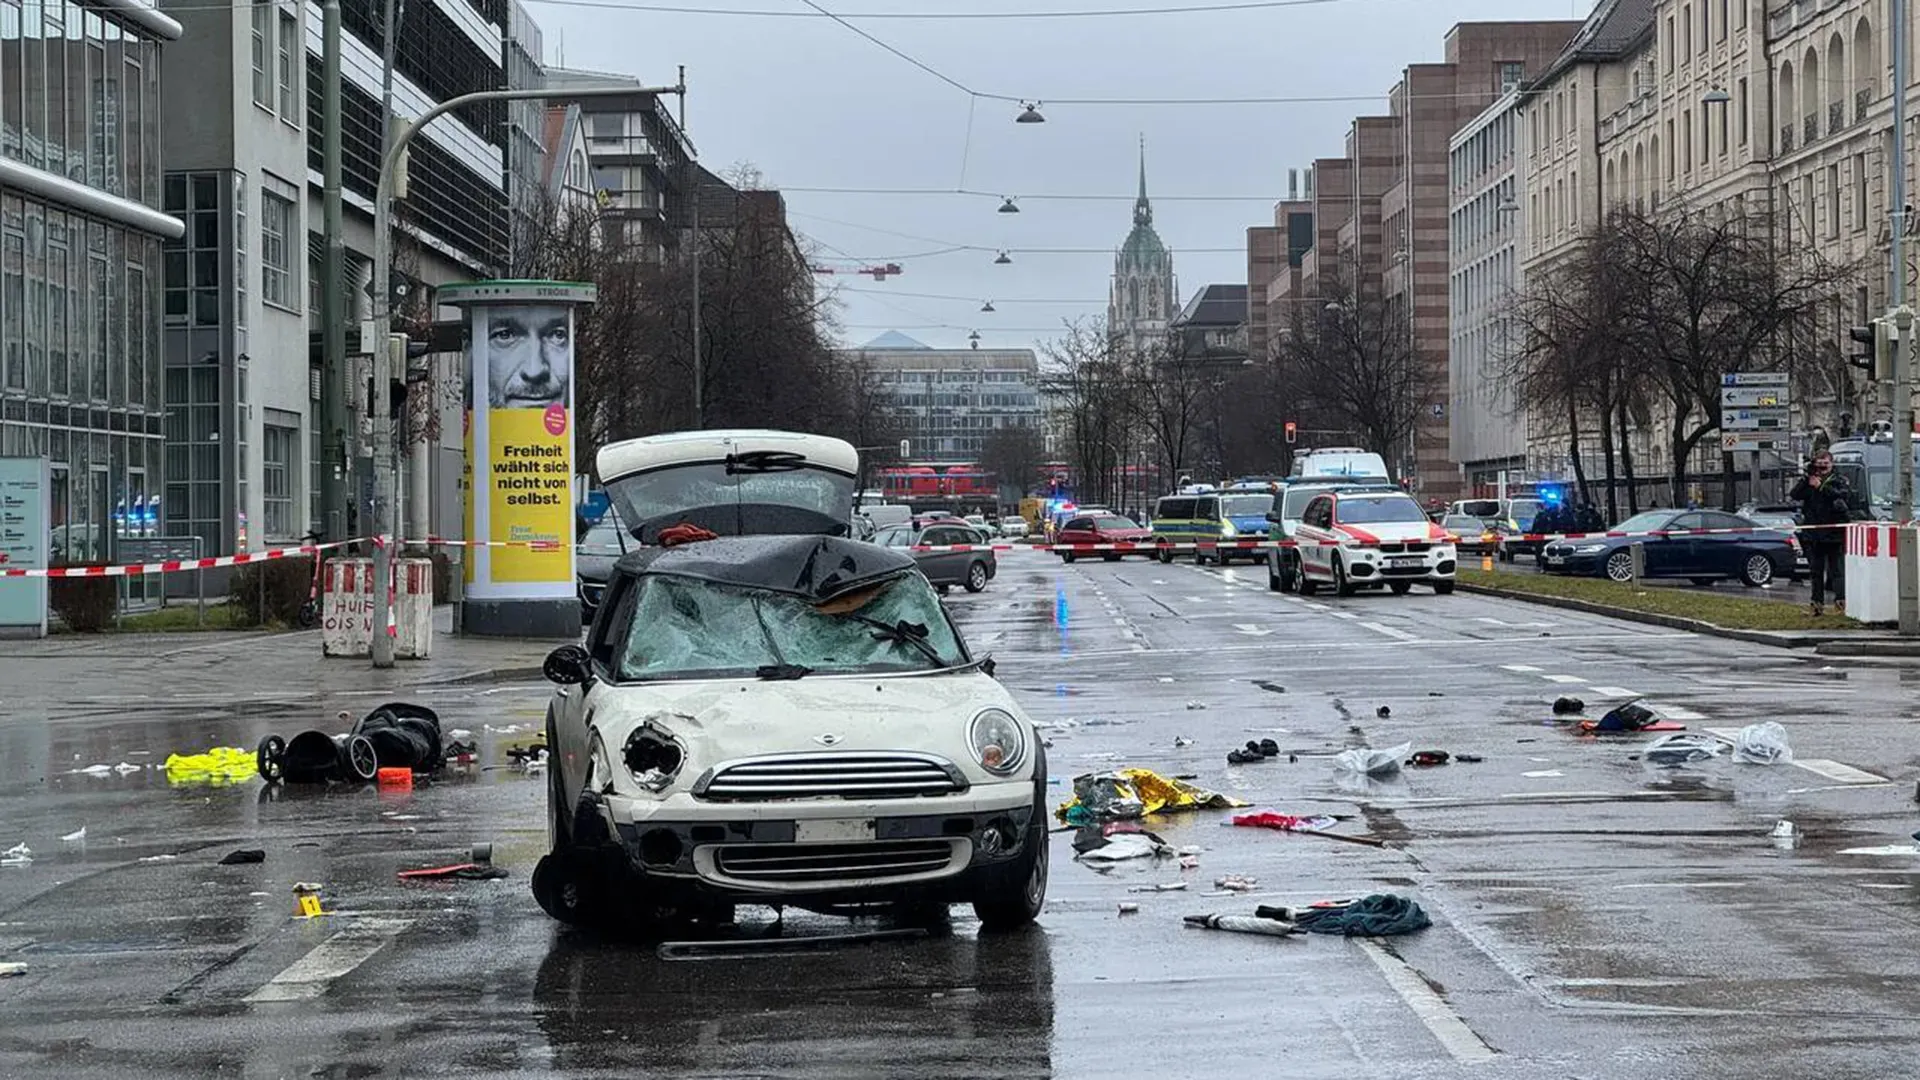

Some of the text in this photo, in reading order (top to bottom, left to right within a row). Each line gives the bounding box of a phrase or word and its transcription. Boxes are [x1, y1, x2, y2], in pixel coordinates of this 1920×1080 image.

[504, 445, 563, 457] Freiheit
[493, 460, 569, 473] wählt sich
[497, 476, 567, 489] nicht von
[507, 493, 561, 505] selbst.
[308, 899, 316, 911] 1
